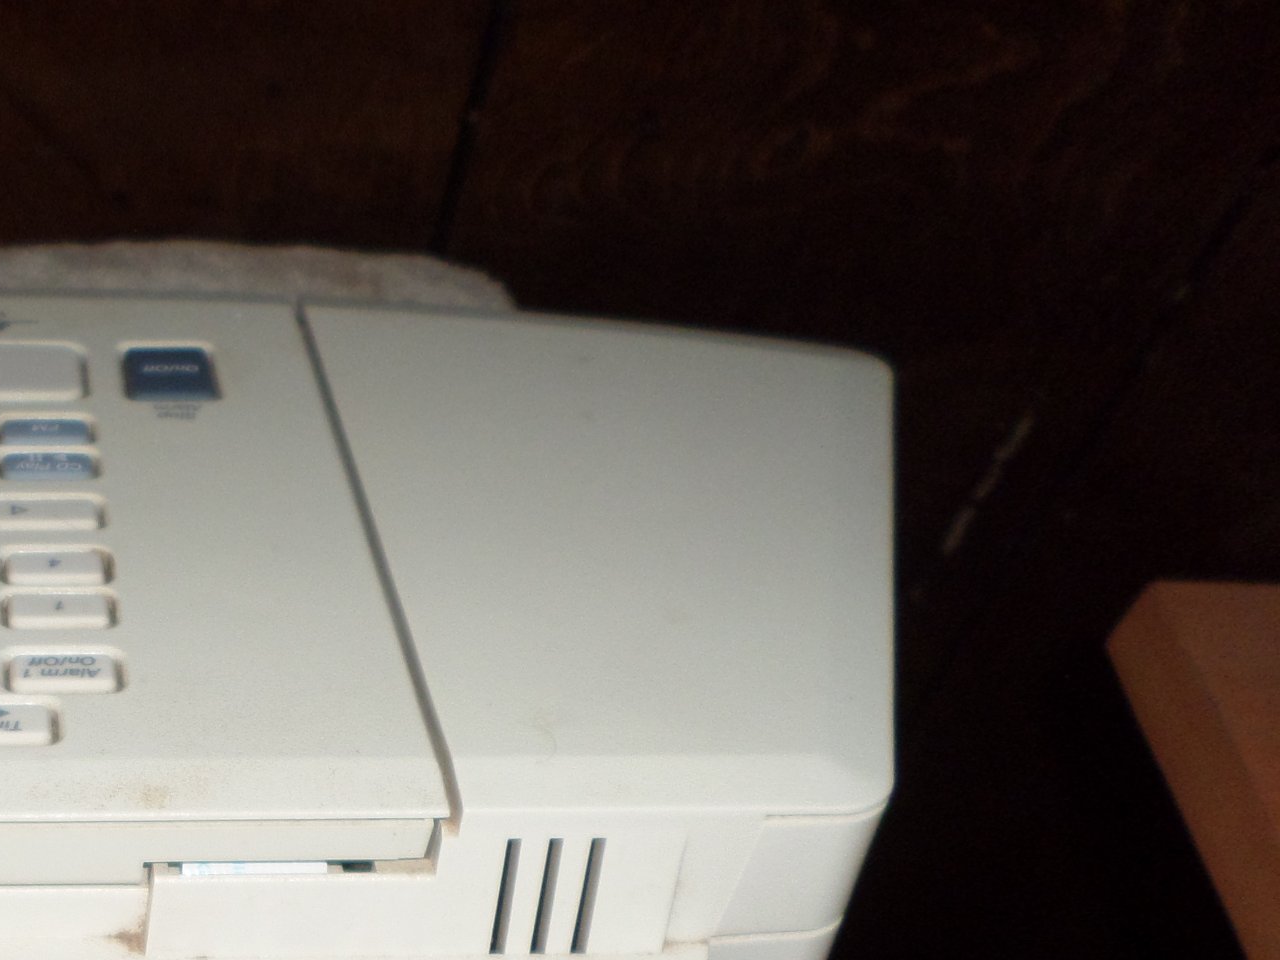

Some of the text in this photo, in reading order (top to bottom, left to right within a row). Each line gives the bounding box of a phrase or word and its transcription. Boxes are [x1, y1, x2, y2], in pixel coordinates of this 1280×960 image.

[32, 424, 61, 433] FM
[48, 559, 63, 569] 4
[55, 601, 66, 612] 1
[26, 655, 97, 668] On/Off
[22, 668, 102, 681] Alarm 1
